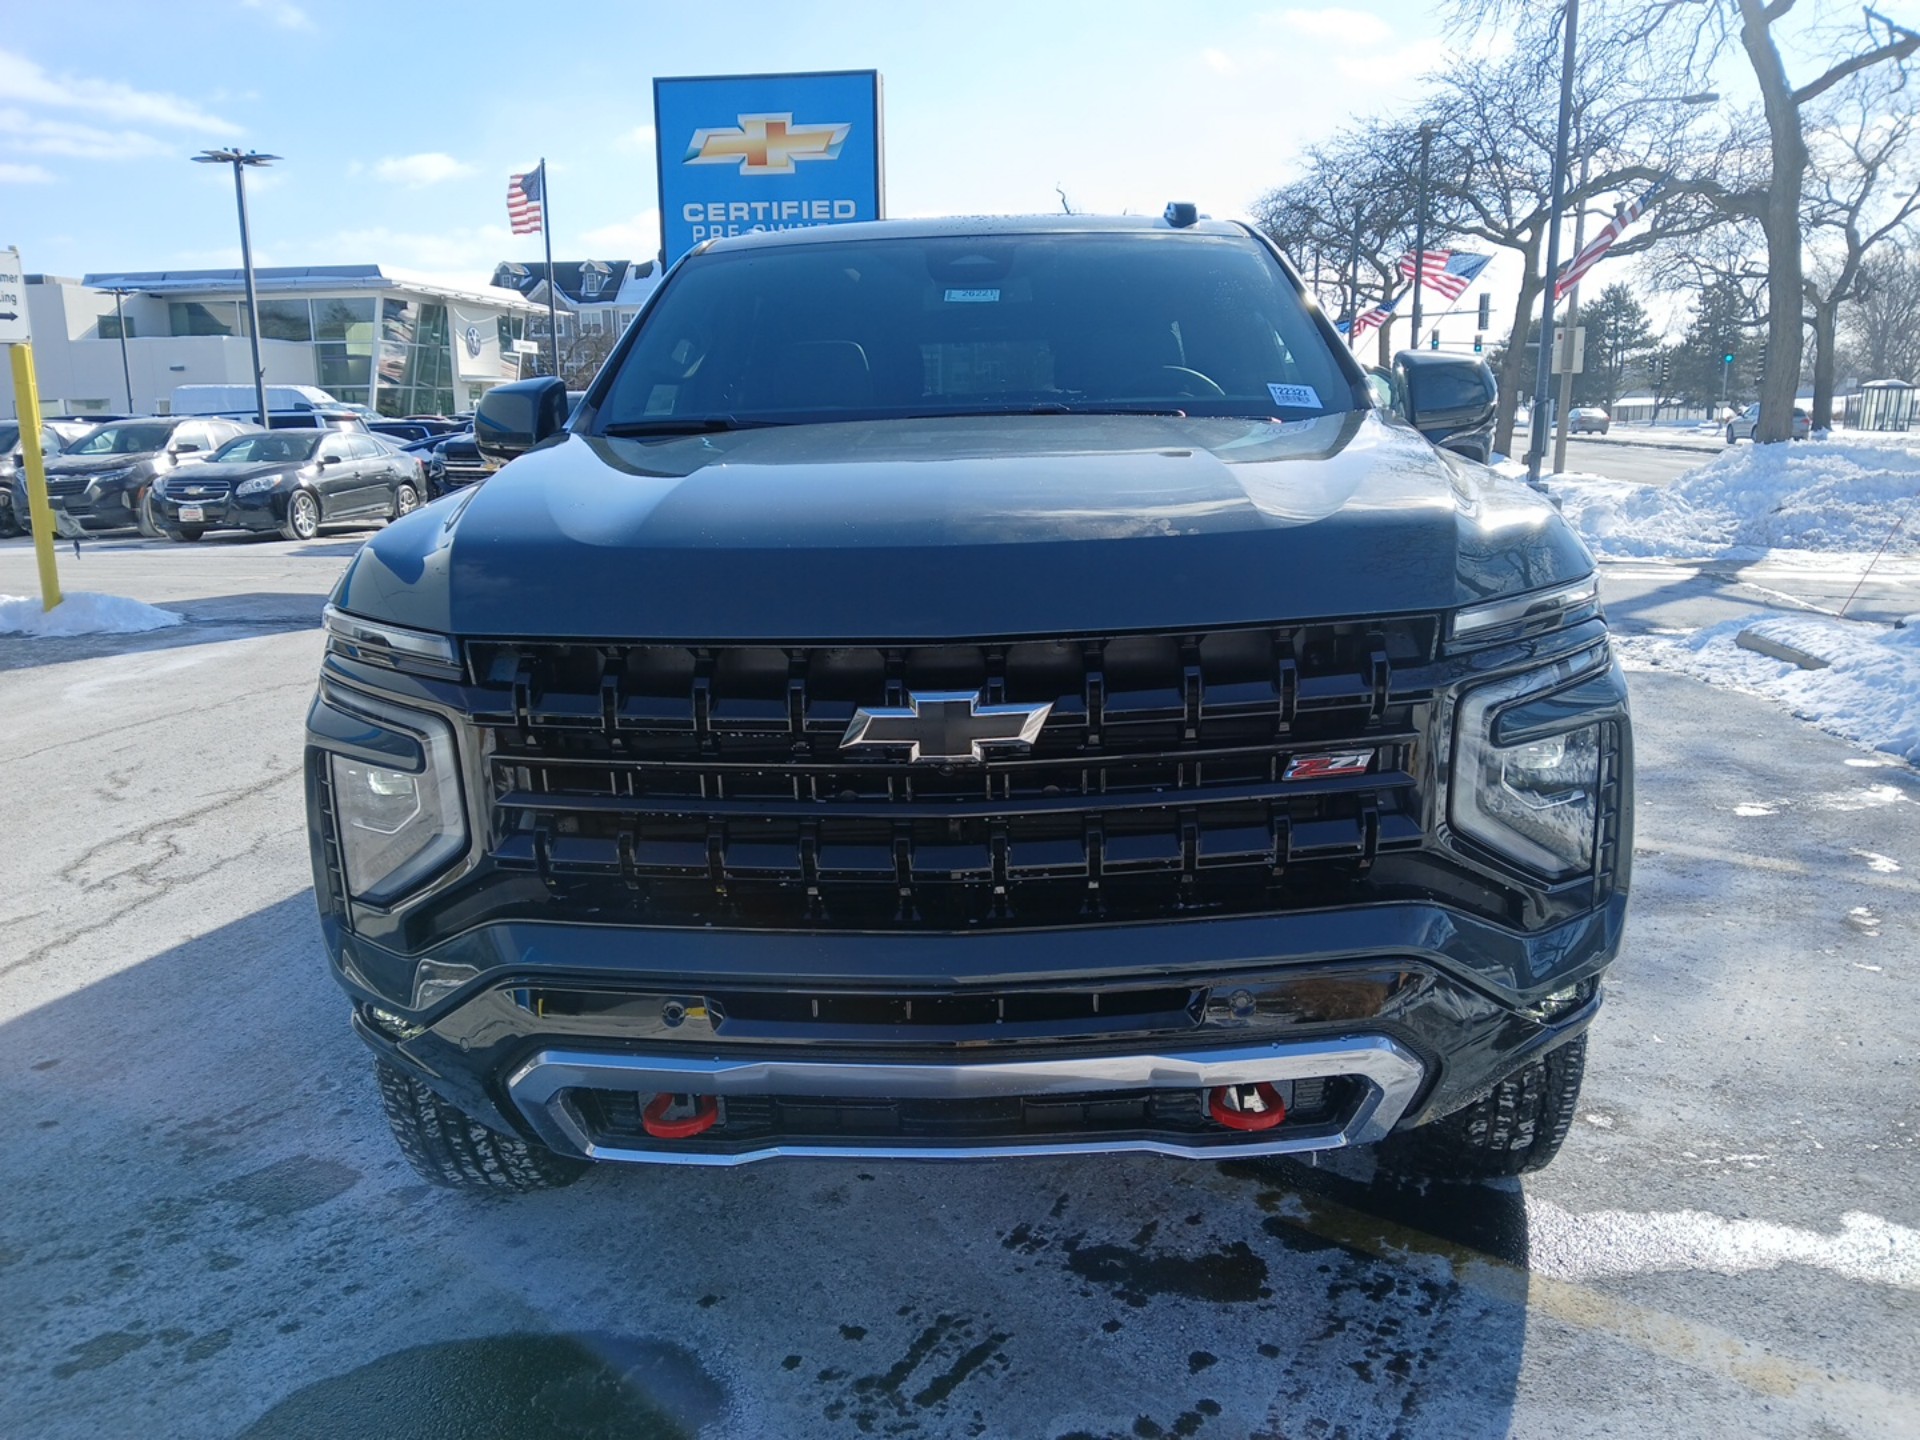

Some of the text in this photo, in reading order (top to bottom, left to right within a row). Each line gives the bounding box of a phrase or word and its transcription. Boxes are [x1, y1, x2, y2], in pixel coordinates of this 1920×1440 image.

[683, 200, 857, 222] CERTIFIED
[0, 290, 17, 306] ing
[1283, 750, 1374, 781] Z71
